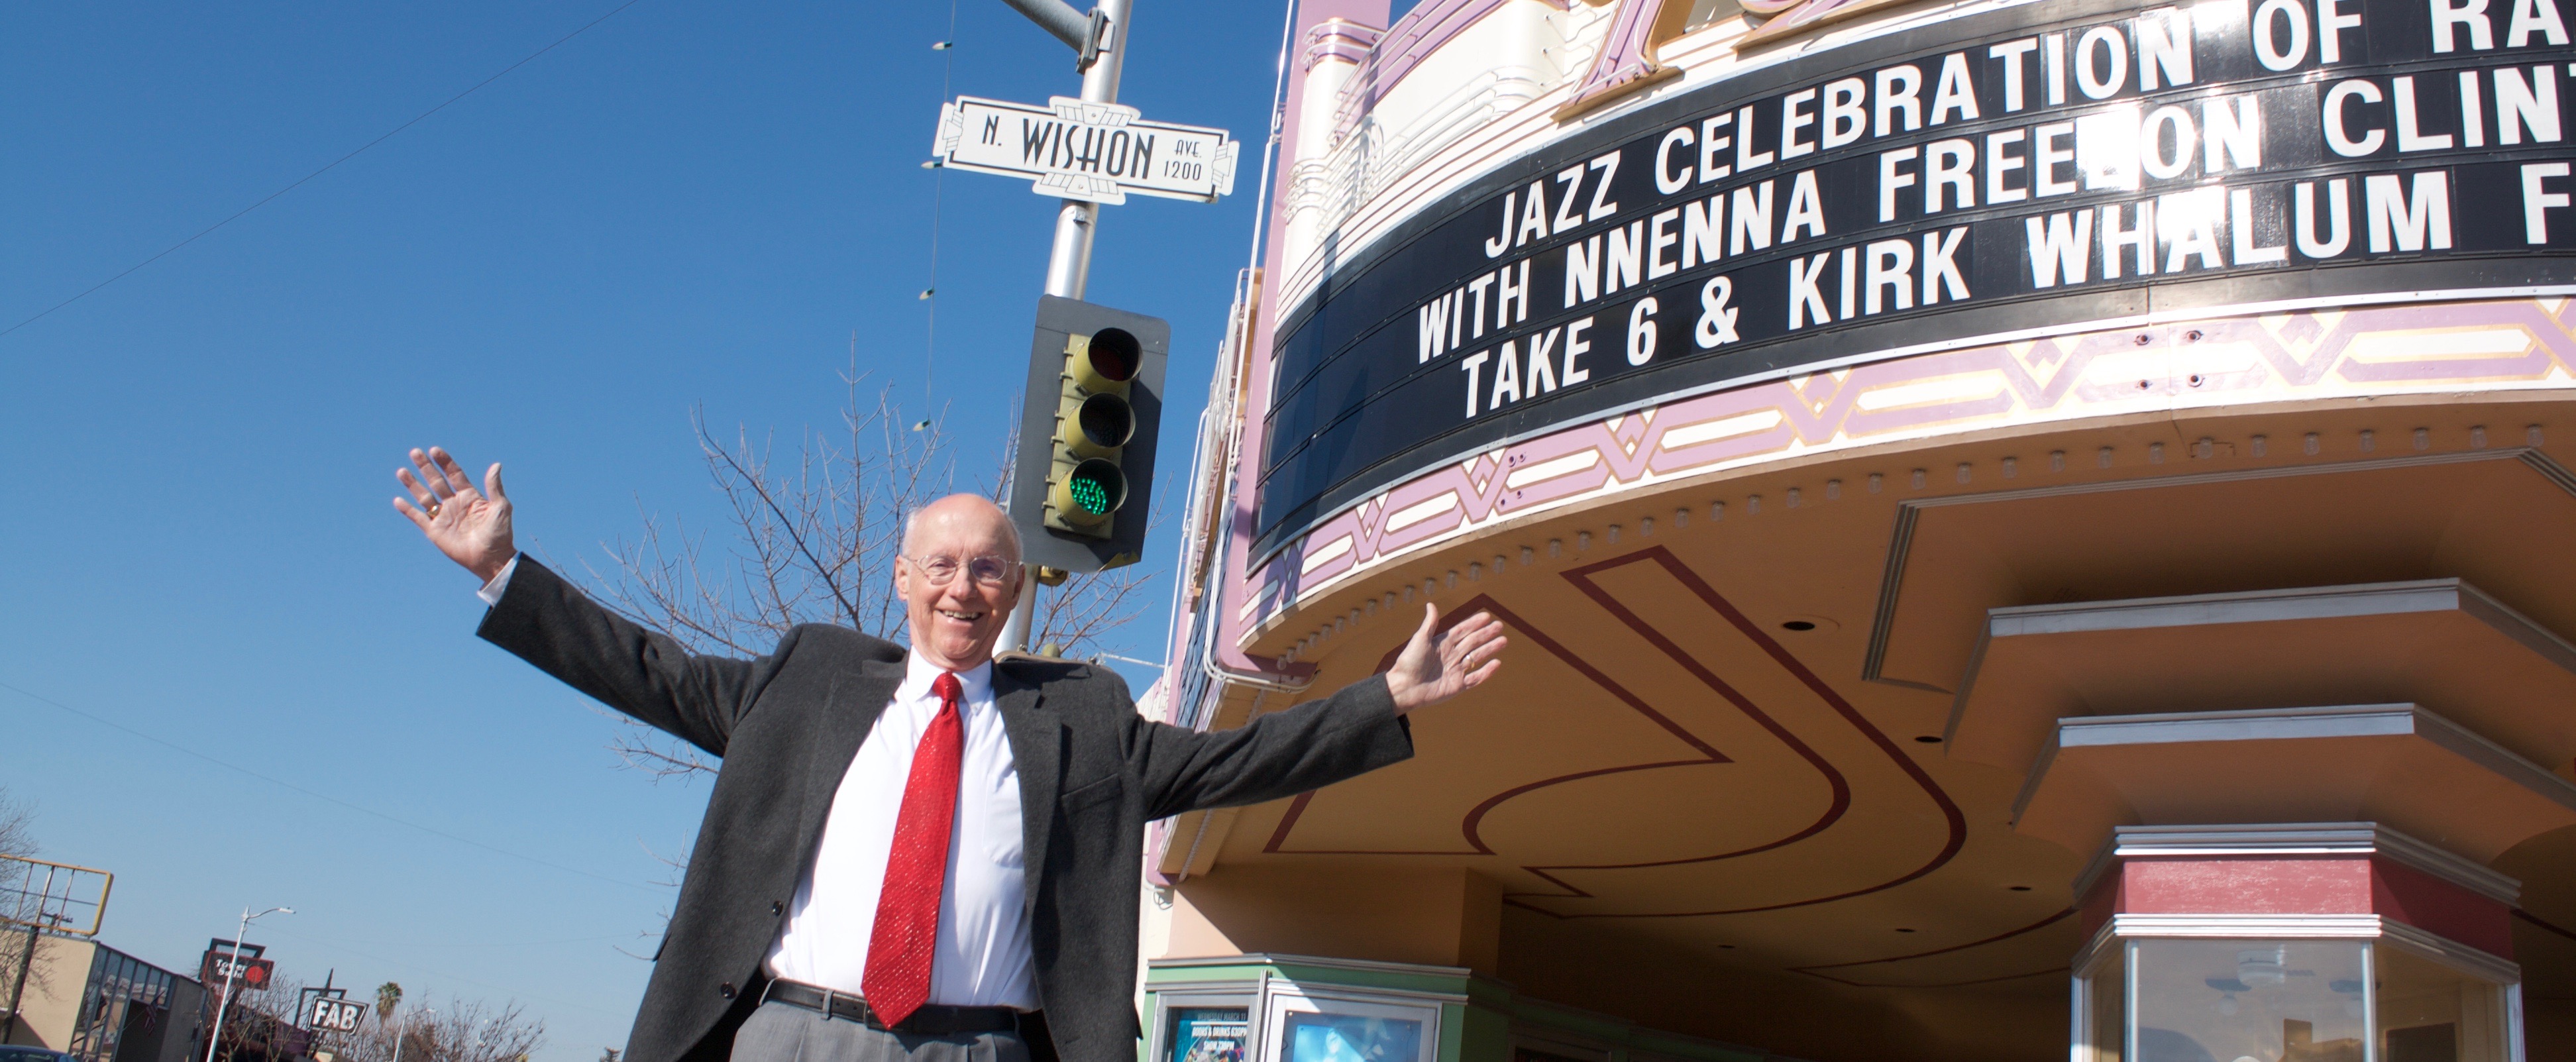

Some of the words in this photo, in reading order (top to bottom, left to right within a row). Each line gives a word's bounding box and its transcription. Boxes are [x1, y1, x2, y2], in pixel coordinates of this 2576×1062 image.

[1485, 150, 1620, 258] JAZZ
[1654, 7, 2193, 195] CELEBRATION
[2253, 0, 2361, 72] OF
[2430, 0, 2570, 52] RA
[983, 114, 1002, 146] N.
[1022, 117, 1155, 180] WISHON
[1175, 140, 1202, 157] AVE.
[1163, 160, 1201, 182] 1200
[1419, 259, 1530, 365] WITH
[1564, 170, 1826, 308] NNENNA
[2322, 64, 2576, 157] CLIN
[1460, 317, 1593, 418] TAKE
[1627, 296, 1657, 366] 6
[1695, 276, 1741, 349] &
[1788, 226, 1972, 331] KIRK
[2026, 171, 2453, 289] WHALUM
[2520, 163, 2571, 244] F
[216, 959, 247, 971] Toer
[313, 1000, 358, 1030] FAB
[1224, 1012, 1240, 1021] MARCH
